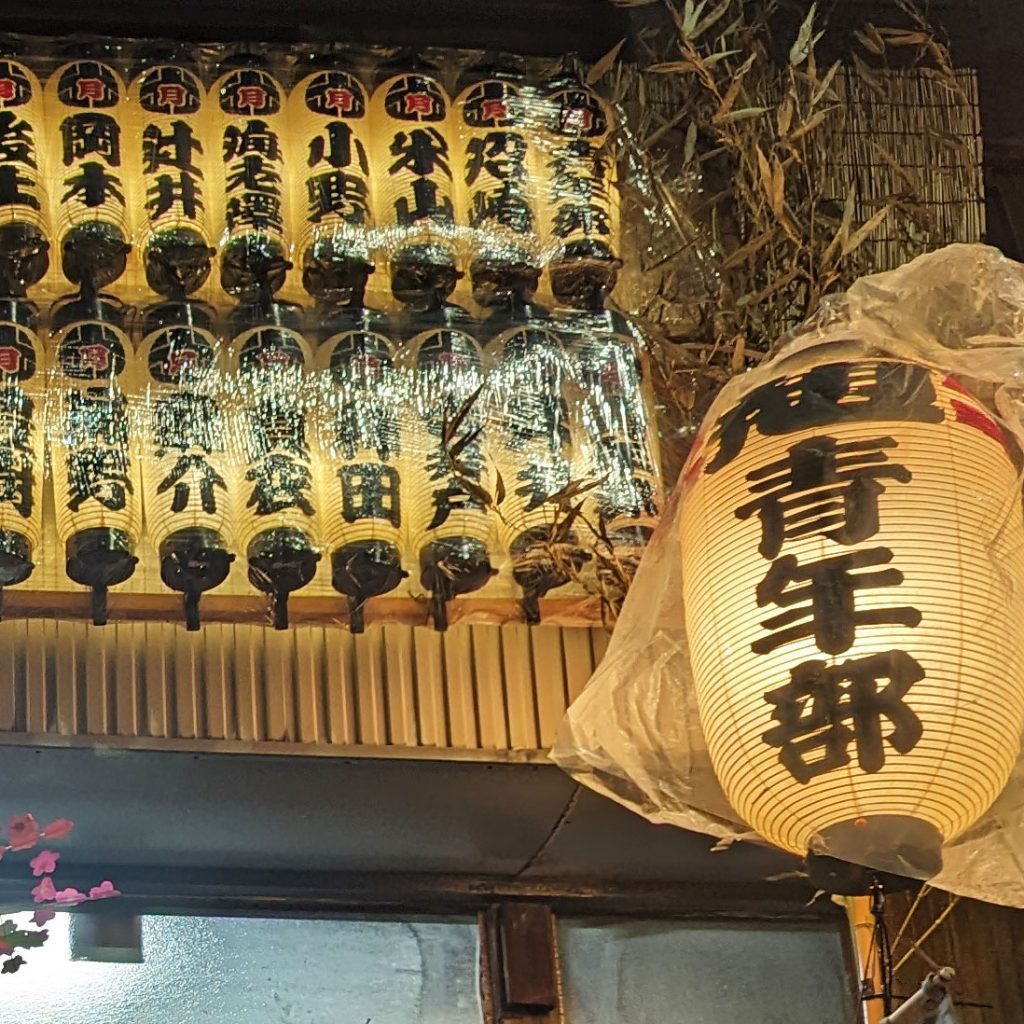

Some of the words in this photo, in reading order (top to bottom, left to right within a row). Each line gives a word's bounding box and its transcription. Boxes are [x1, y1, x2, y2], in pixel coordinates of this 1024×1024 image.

[60, 113, 126, 208] 岡本
[388, 127, 454, 226] 米山
[734, 436, 926, 785] 青年部
